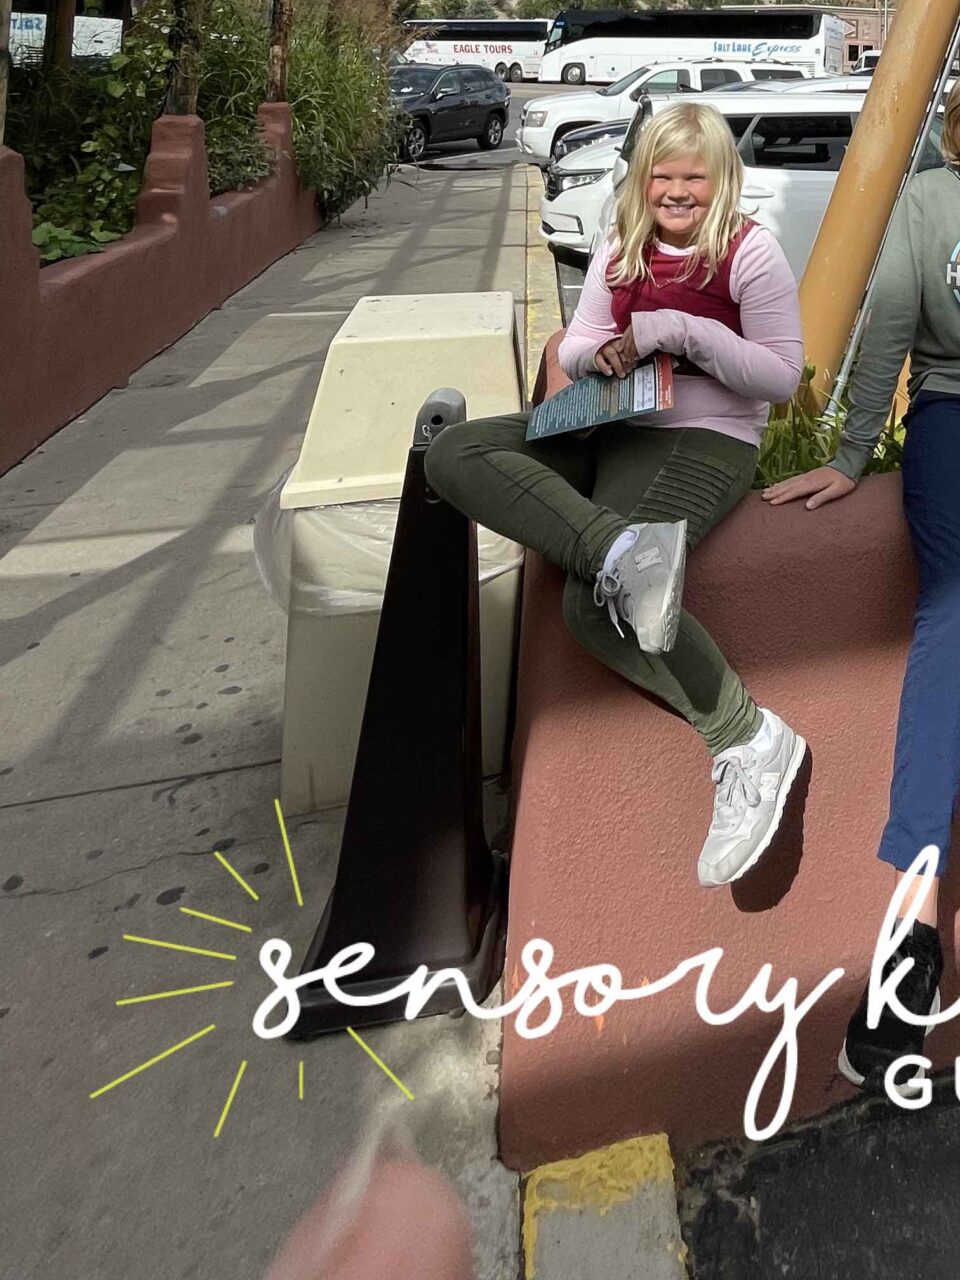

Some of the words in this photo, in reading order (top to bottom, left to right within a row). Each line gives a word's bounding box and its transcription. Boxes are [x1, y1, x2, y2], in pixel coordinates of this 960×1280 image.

[453, 44, 481, 54] EAGLE
[483, 44, 513, 54] TOURS
[752, 42, 802, 57] Express
